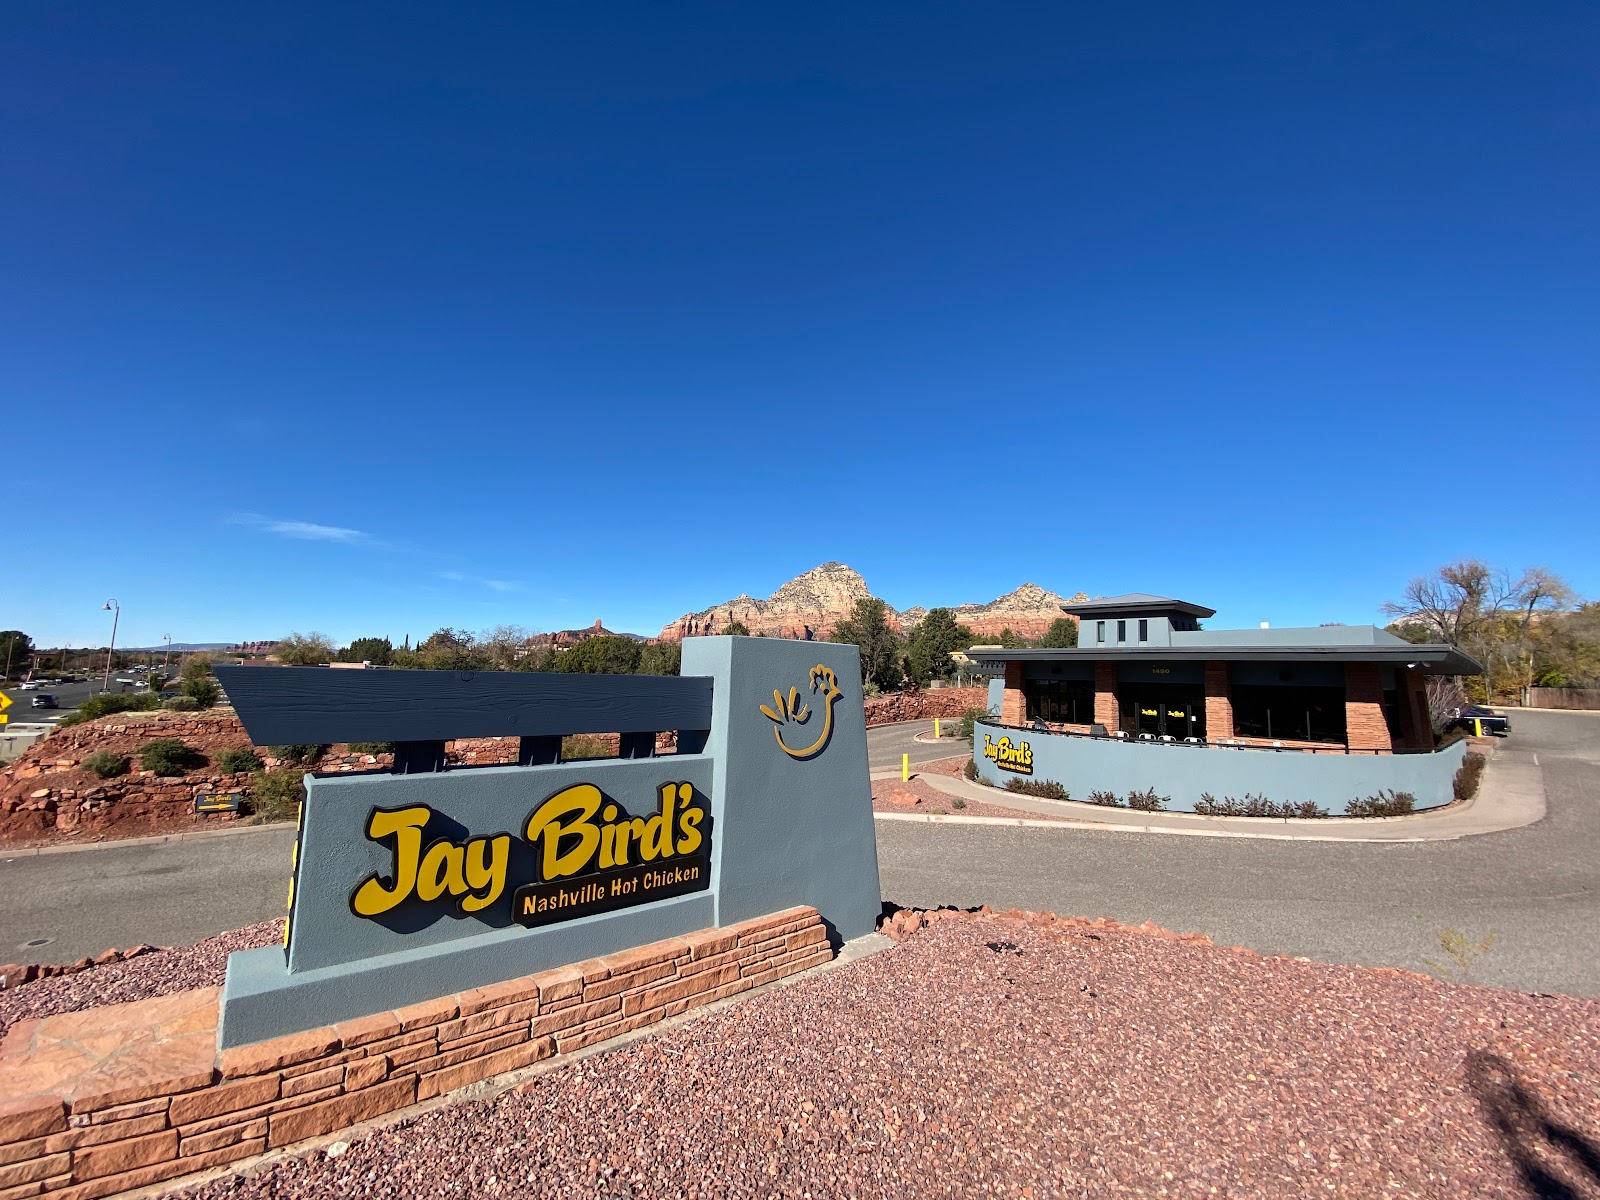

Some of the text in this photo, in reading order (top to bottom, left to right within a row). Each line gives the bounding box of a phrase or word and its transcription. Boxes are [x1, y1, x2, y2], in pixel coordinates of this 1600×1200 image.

[983, 734, 1032, 765] Jay Bird's
[353, 807, 510, 916] Jay
[527, 782, 704, 881] Bird's
[523, 866, 699, 915] Nashville Hot Chicken
